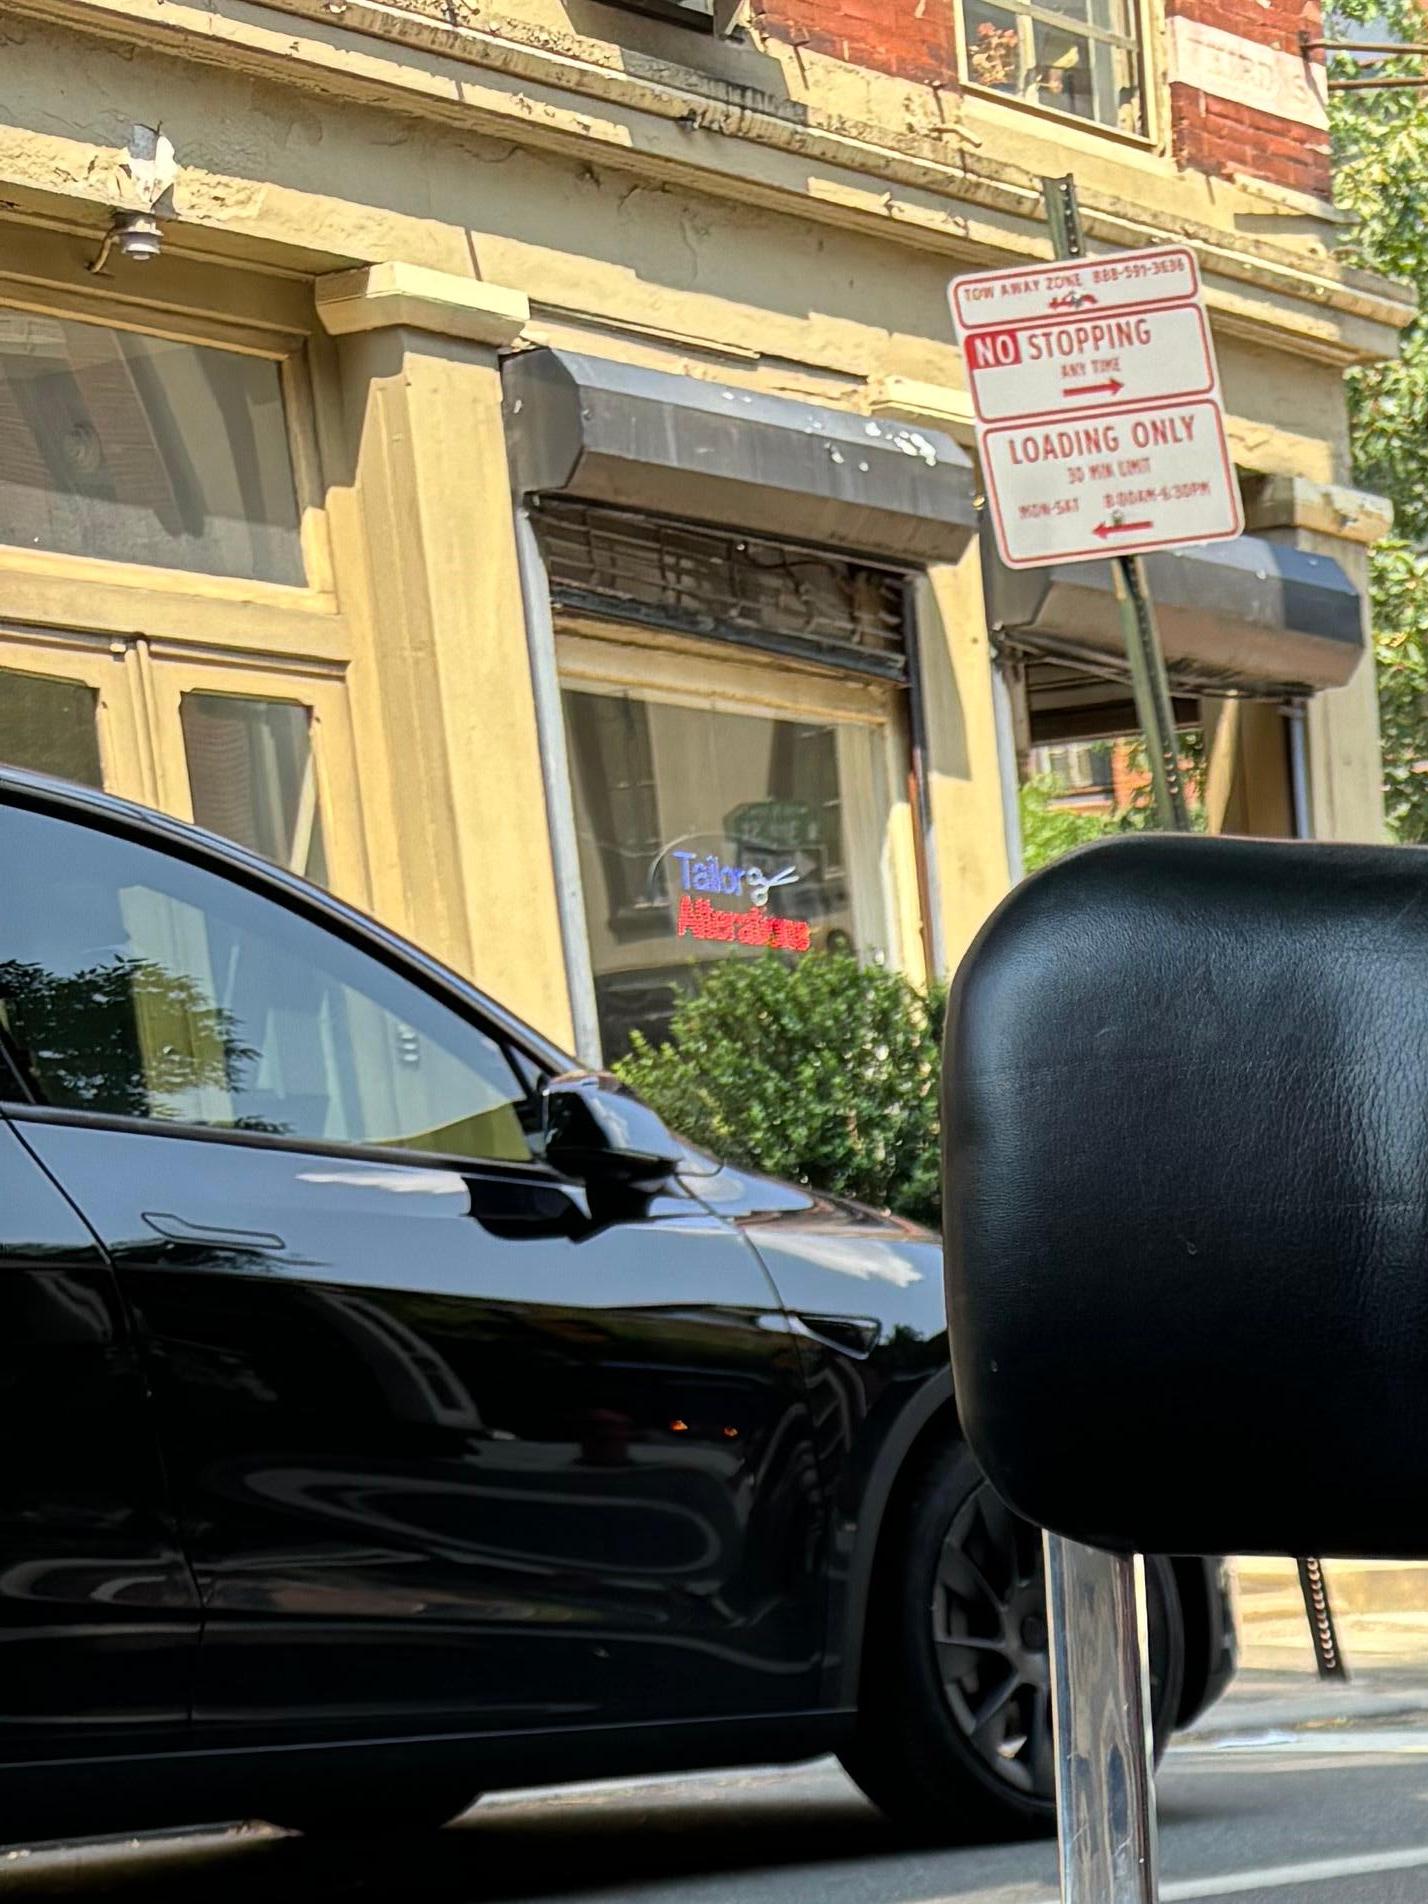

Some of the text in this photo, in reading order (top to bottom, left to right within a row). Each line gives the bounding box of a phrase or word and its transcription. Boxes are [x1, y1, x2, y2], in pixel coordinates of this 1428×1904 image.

[964, 286, 994, 302] TOW
[1001, 279, 1040, 297] AWAY
[1046, 272, 1083, 291] ZONE
[974, 318, 1152, 368] NO STOPPING
[1060, 356, 1122, 379] ANY TIME
[1007, 414, 1196, 466] LOADING ONLY
[672, 850, 746, 896] Tailor
